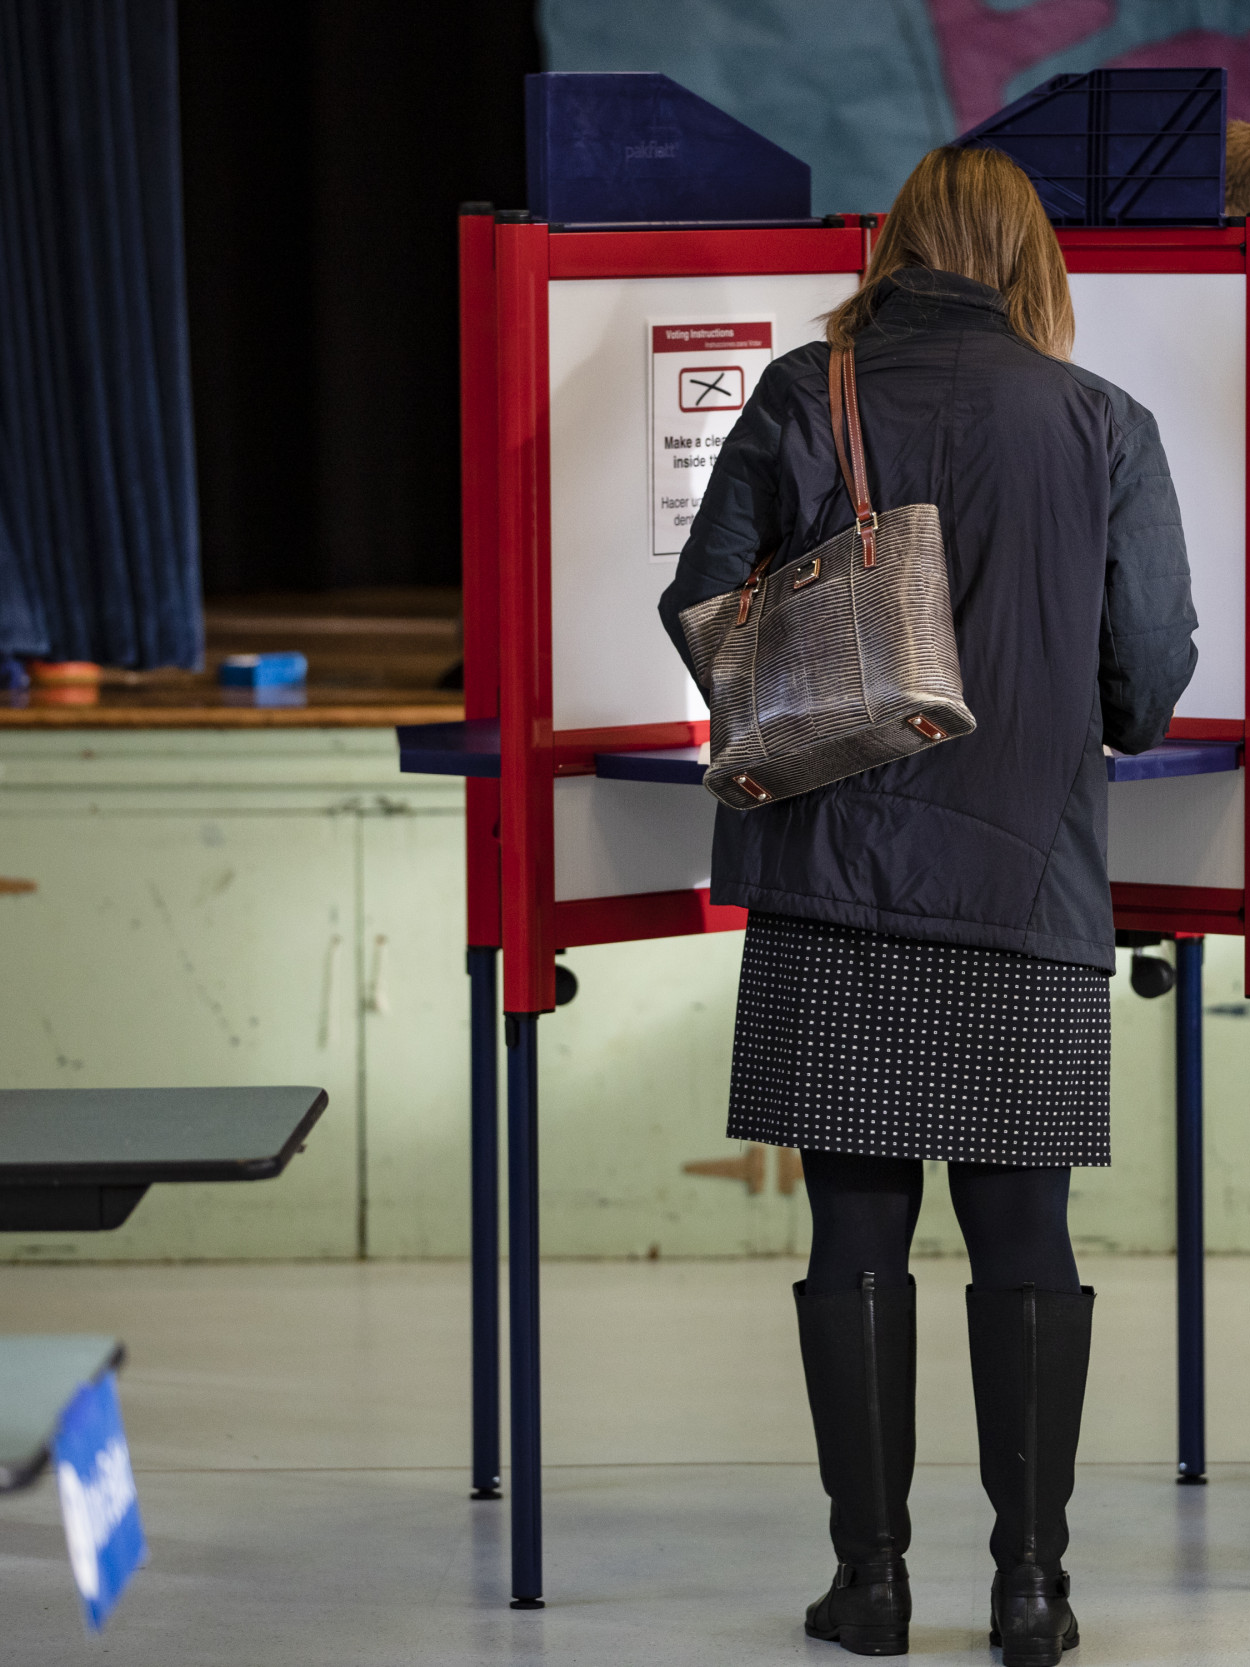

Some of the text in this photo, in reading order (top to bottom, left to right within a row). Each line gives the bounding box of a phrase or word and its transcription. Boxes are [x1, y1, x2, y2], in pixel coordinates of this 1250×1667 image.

[666, 328, 735, 341] Voting Instructions
[664, 436, 692, 449] Make
[695, 437, 702, 448] a
[673, 454, 706, 469] inside
[661, 496, 689, 509] Hacer
